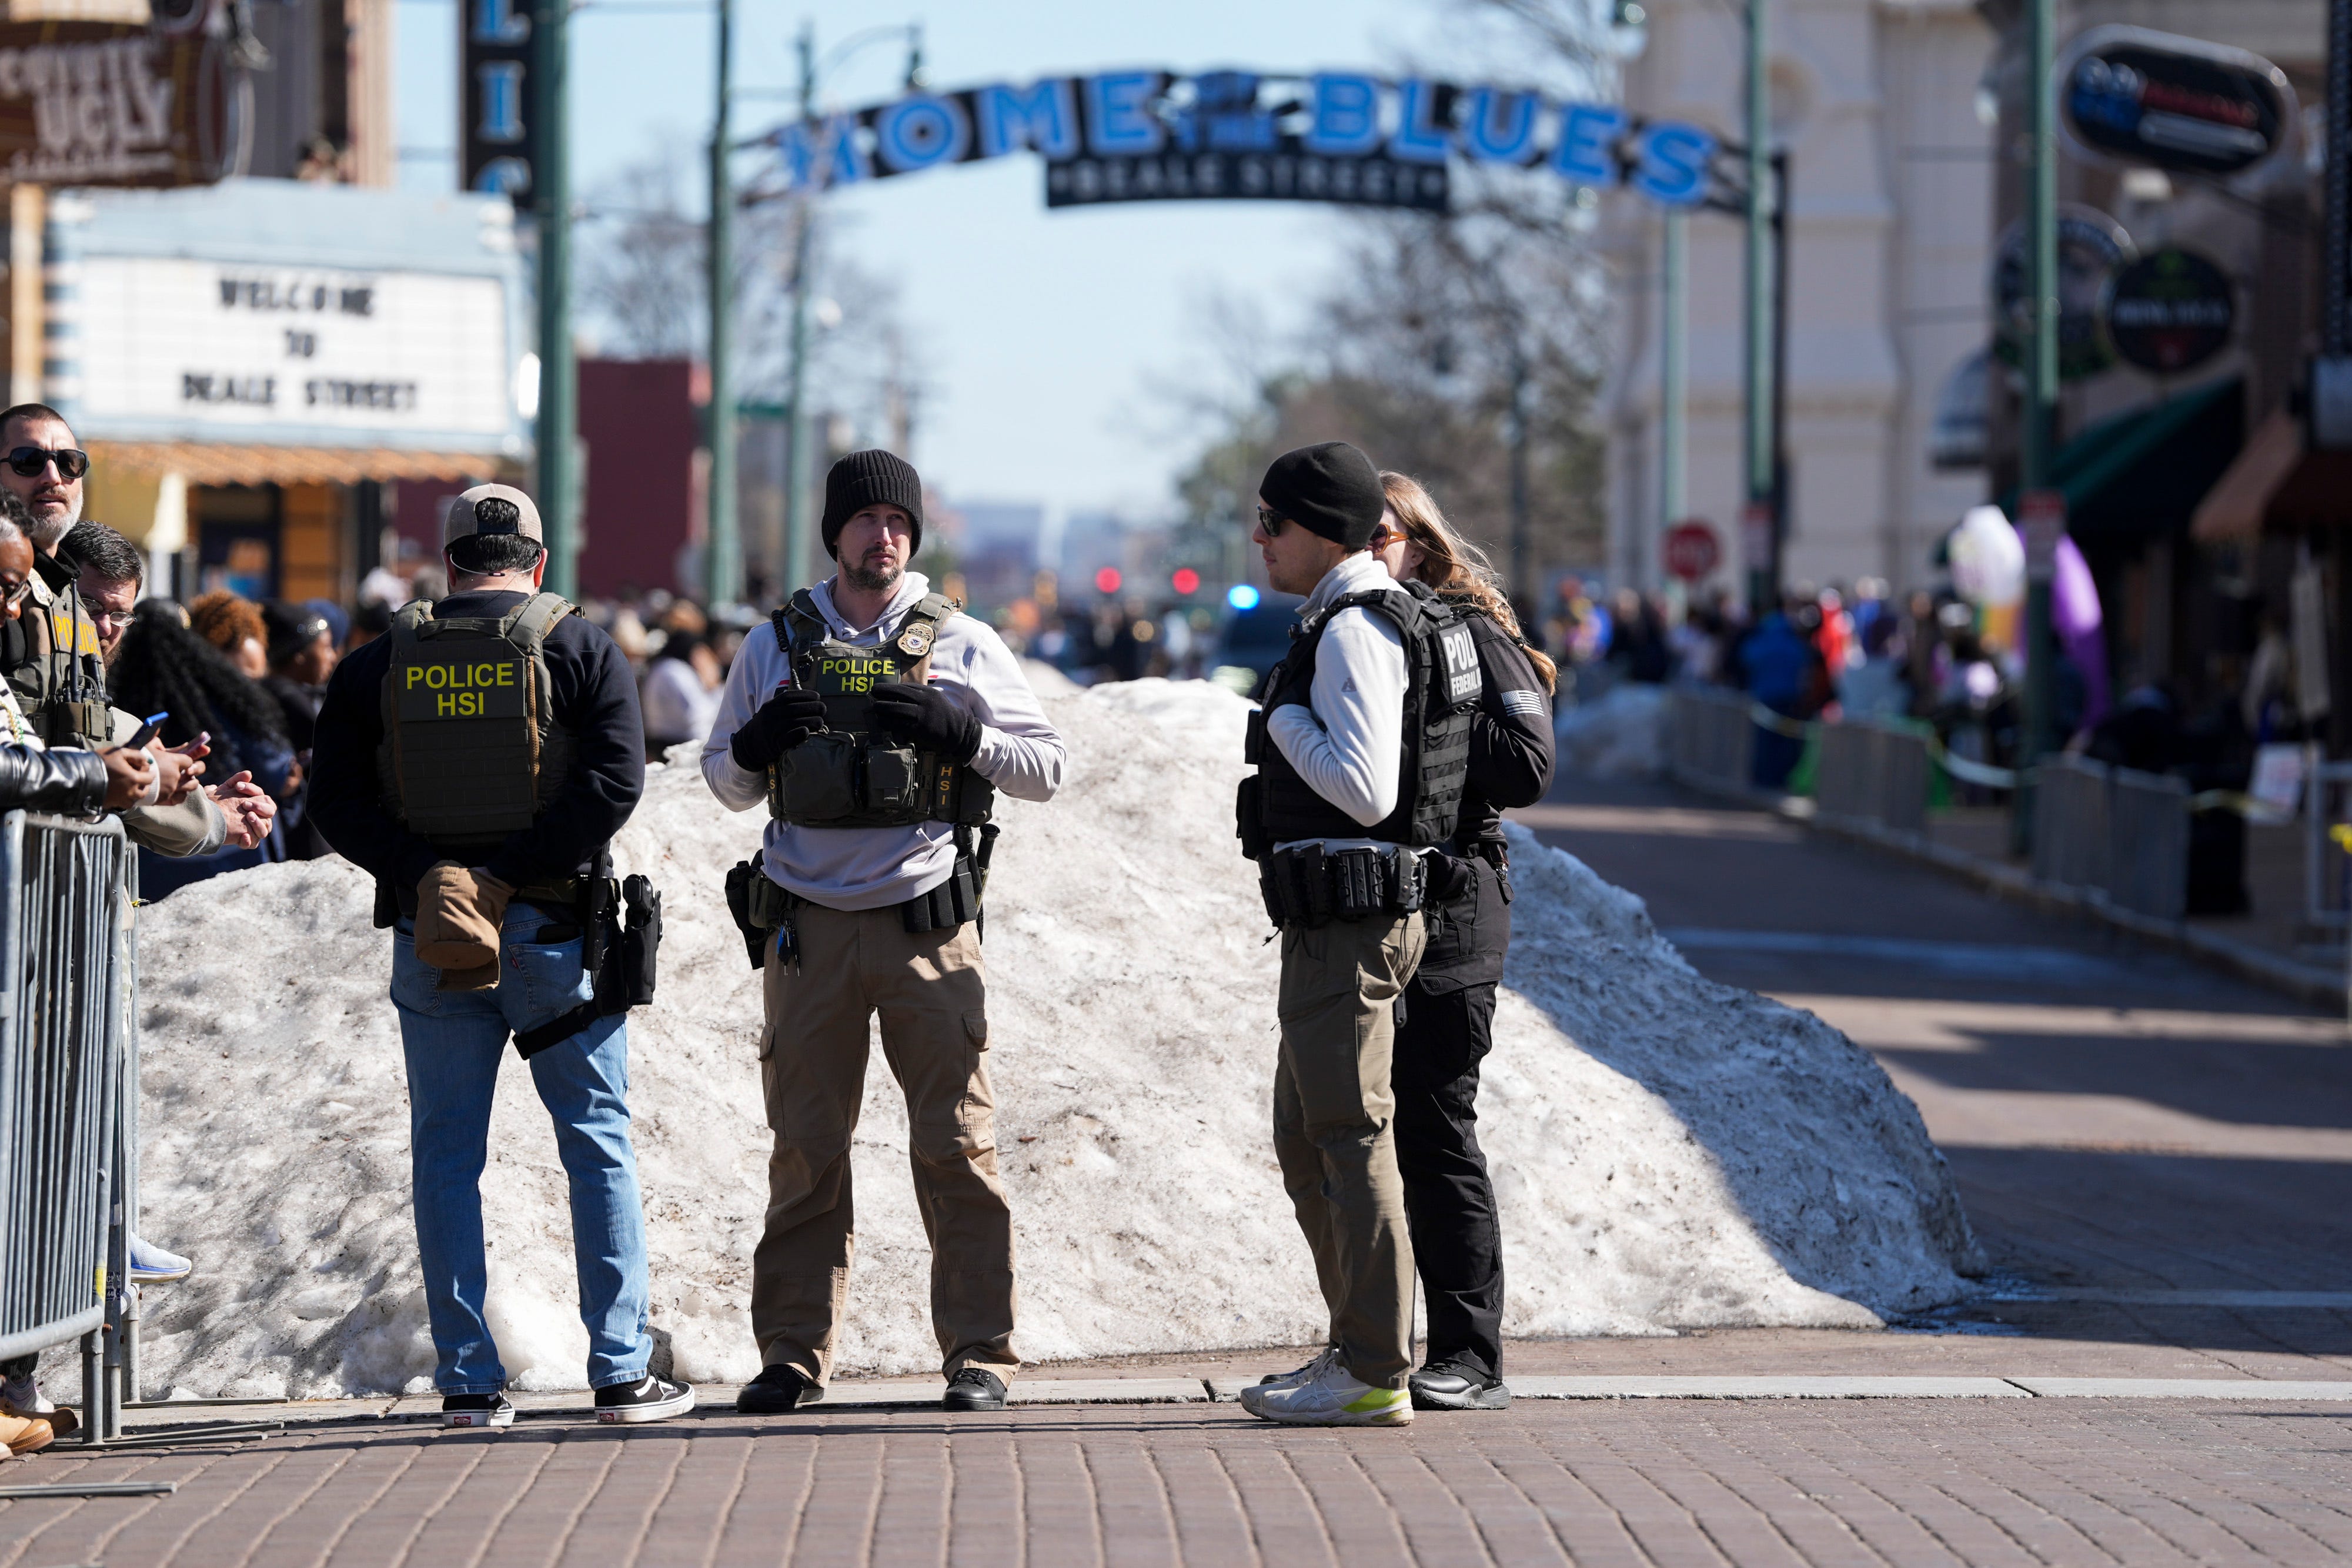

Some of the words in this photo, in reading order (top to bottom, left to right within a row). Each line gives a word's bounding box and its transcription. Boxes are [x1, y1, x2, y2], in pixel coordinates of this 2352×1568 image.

[1304, 71, 1719, 206] BLUES
[1238, 154, 1415, 201] STREET
[218, 278, 375, 317] WELCOME
[283, 329, 316, 358] TO
[183, 373, 276, 405] BEALE
[305, 379, 417, 410] STREET
[407, 663, 514, 690] POLICE
[822, 659, 895, 675] POLICE
[841, 677, 874, 692] HSI
[437, 692, 484, 716] HSI
[940, 766, 953, 805] HSI
